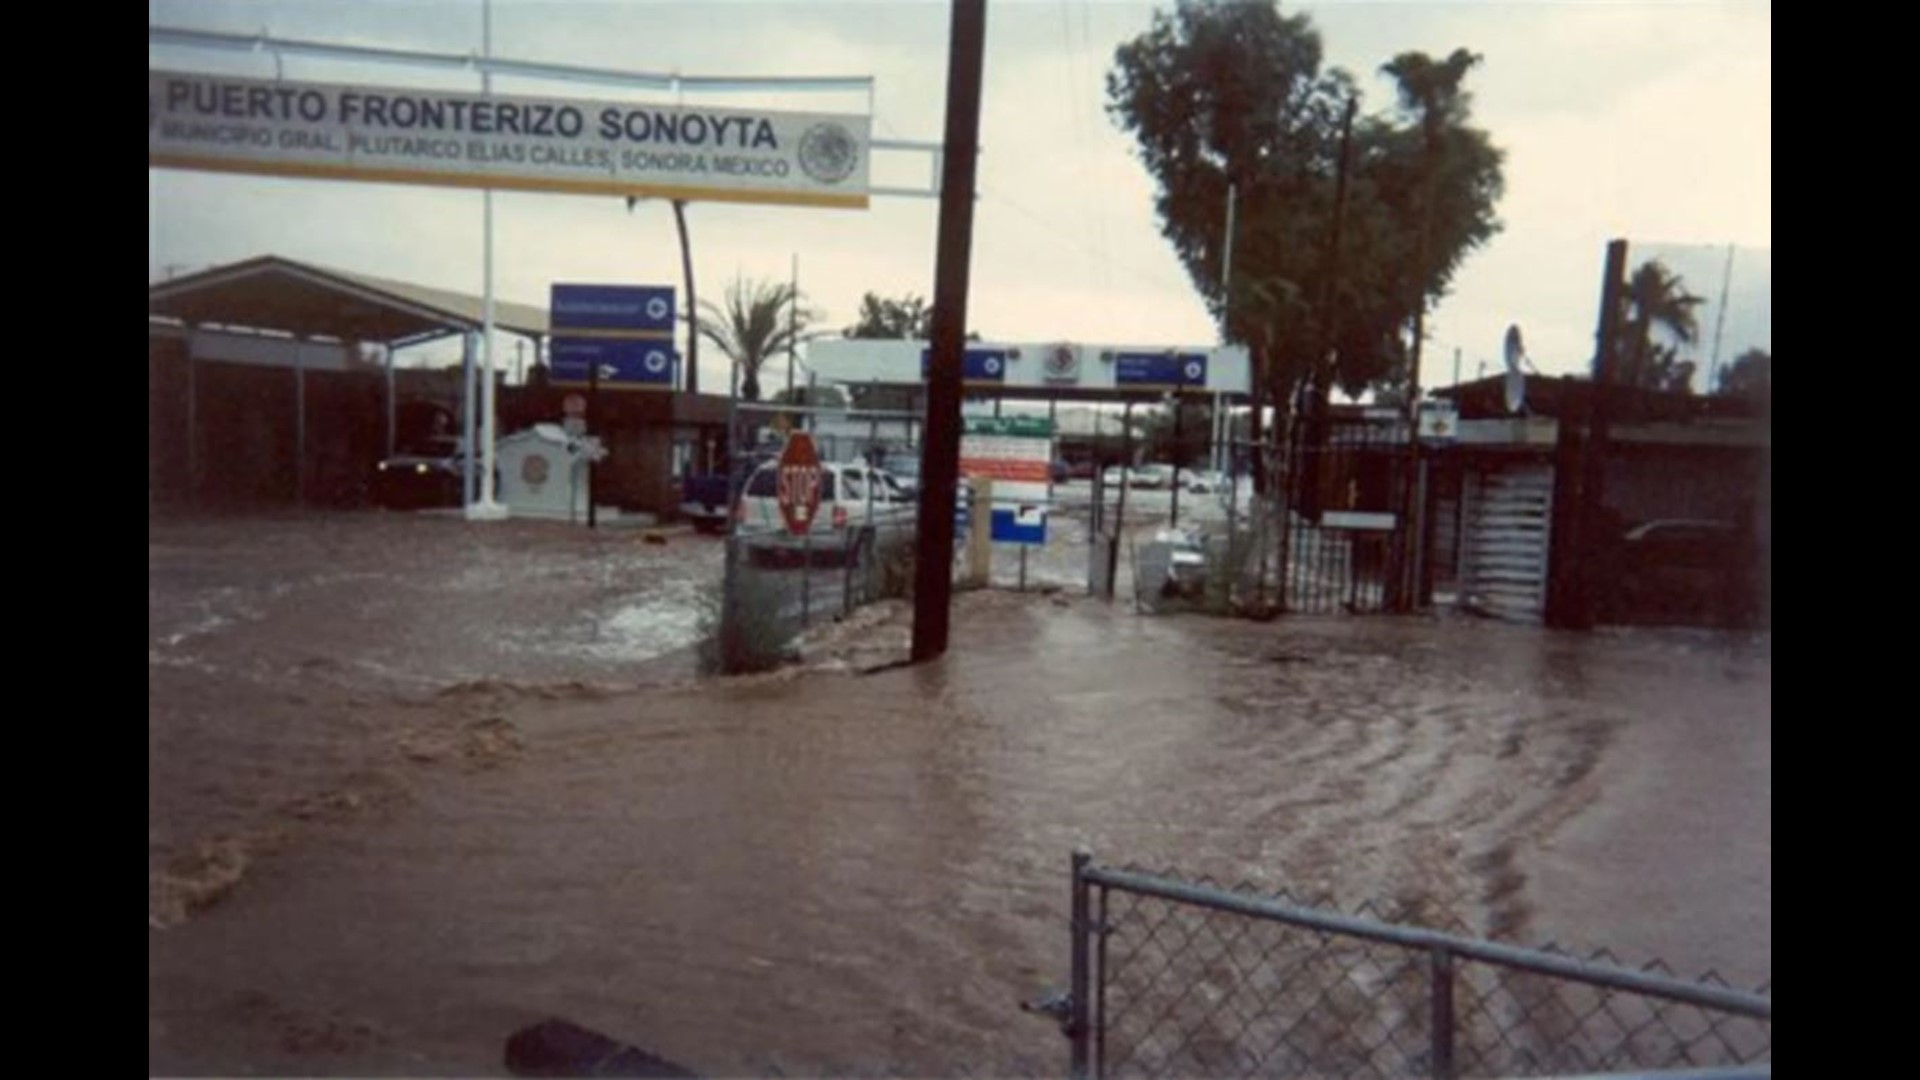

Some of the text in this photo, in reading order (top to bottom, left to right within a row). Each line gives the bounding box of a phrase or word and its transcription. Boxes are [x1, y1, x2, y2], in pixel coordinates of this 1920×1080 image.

[168, 80, 777, 150] PUERTO FRONTERIZO SONOYTA
[162, 121, 271, 146] MUNICIPIO
[349, 135, 460, 159] PLUTARCO
[467, 141, 525, 164] ELIAS
[622, 150, 707, 174] SONORA
[714, 155, 789, 178] MEXICO
[781, 465, 819, 505] STOP
